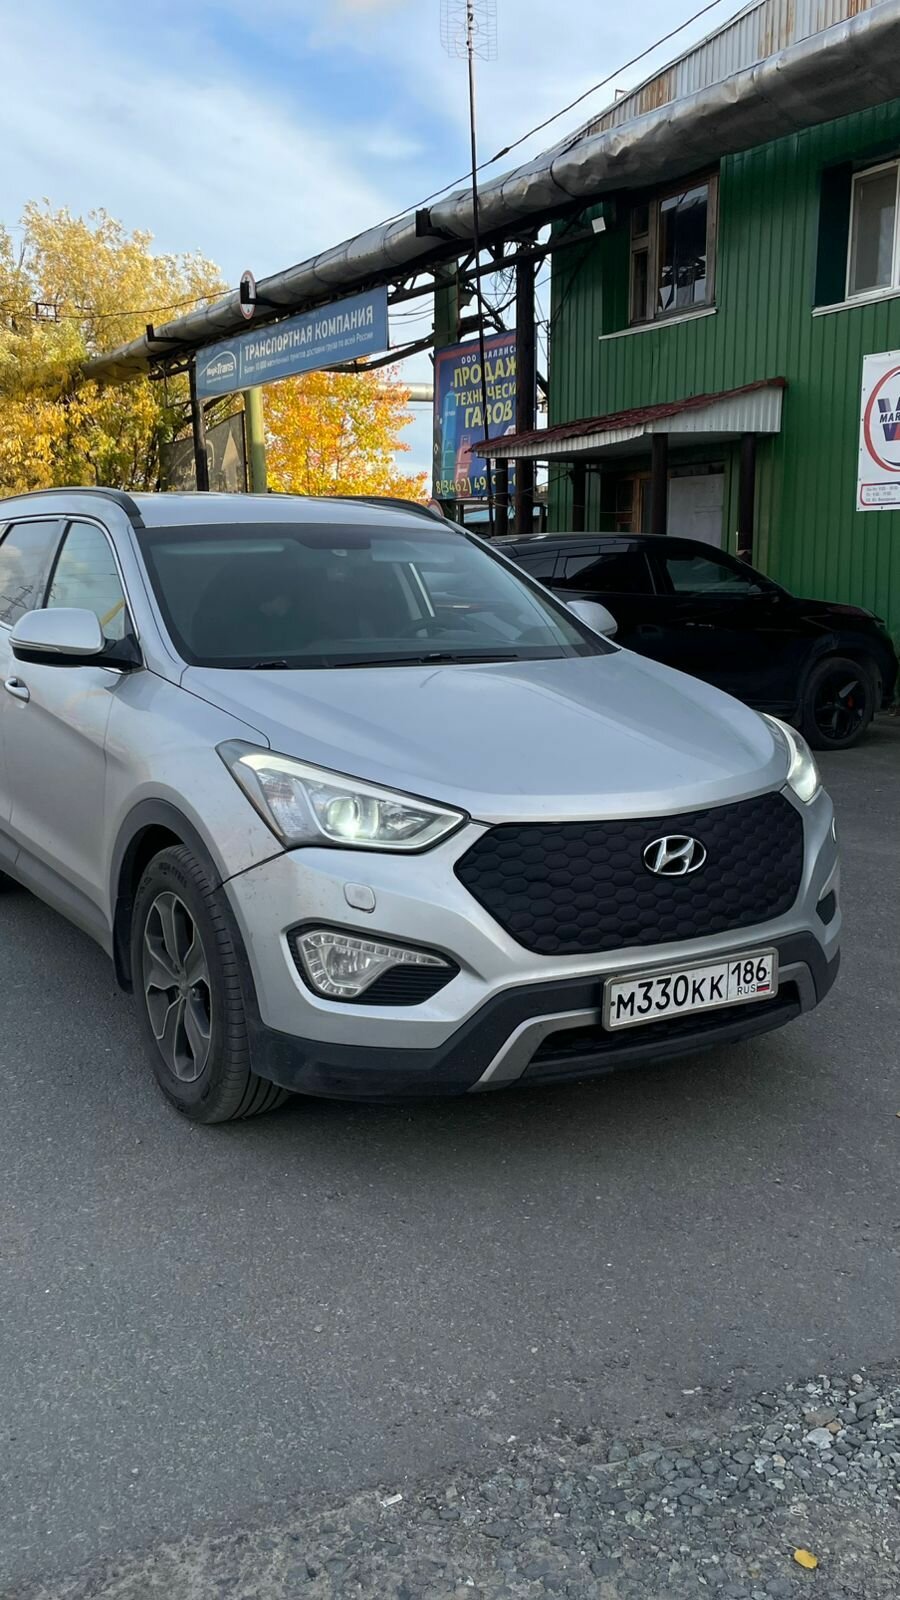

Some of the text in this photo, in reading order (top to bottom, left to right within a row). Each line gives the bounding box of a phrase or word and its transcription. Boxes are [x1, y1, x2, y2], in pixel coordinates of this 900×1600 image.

[244, 304, 374, 361] ТРАНСПОРТНАЯ КОМПАНИЯ
[454, 355, 516, 388] ПРОДАЖ
[461, 354, 477, 364] ООО
[465, 400, 512, 428] ГАЗОВ
[616, 958, 768, 1019] М330КК 186
[737, 983, 756, 996] RUS
